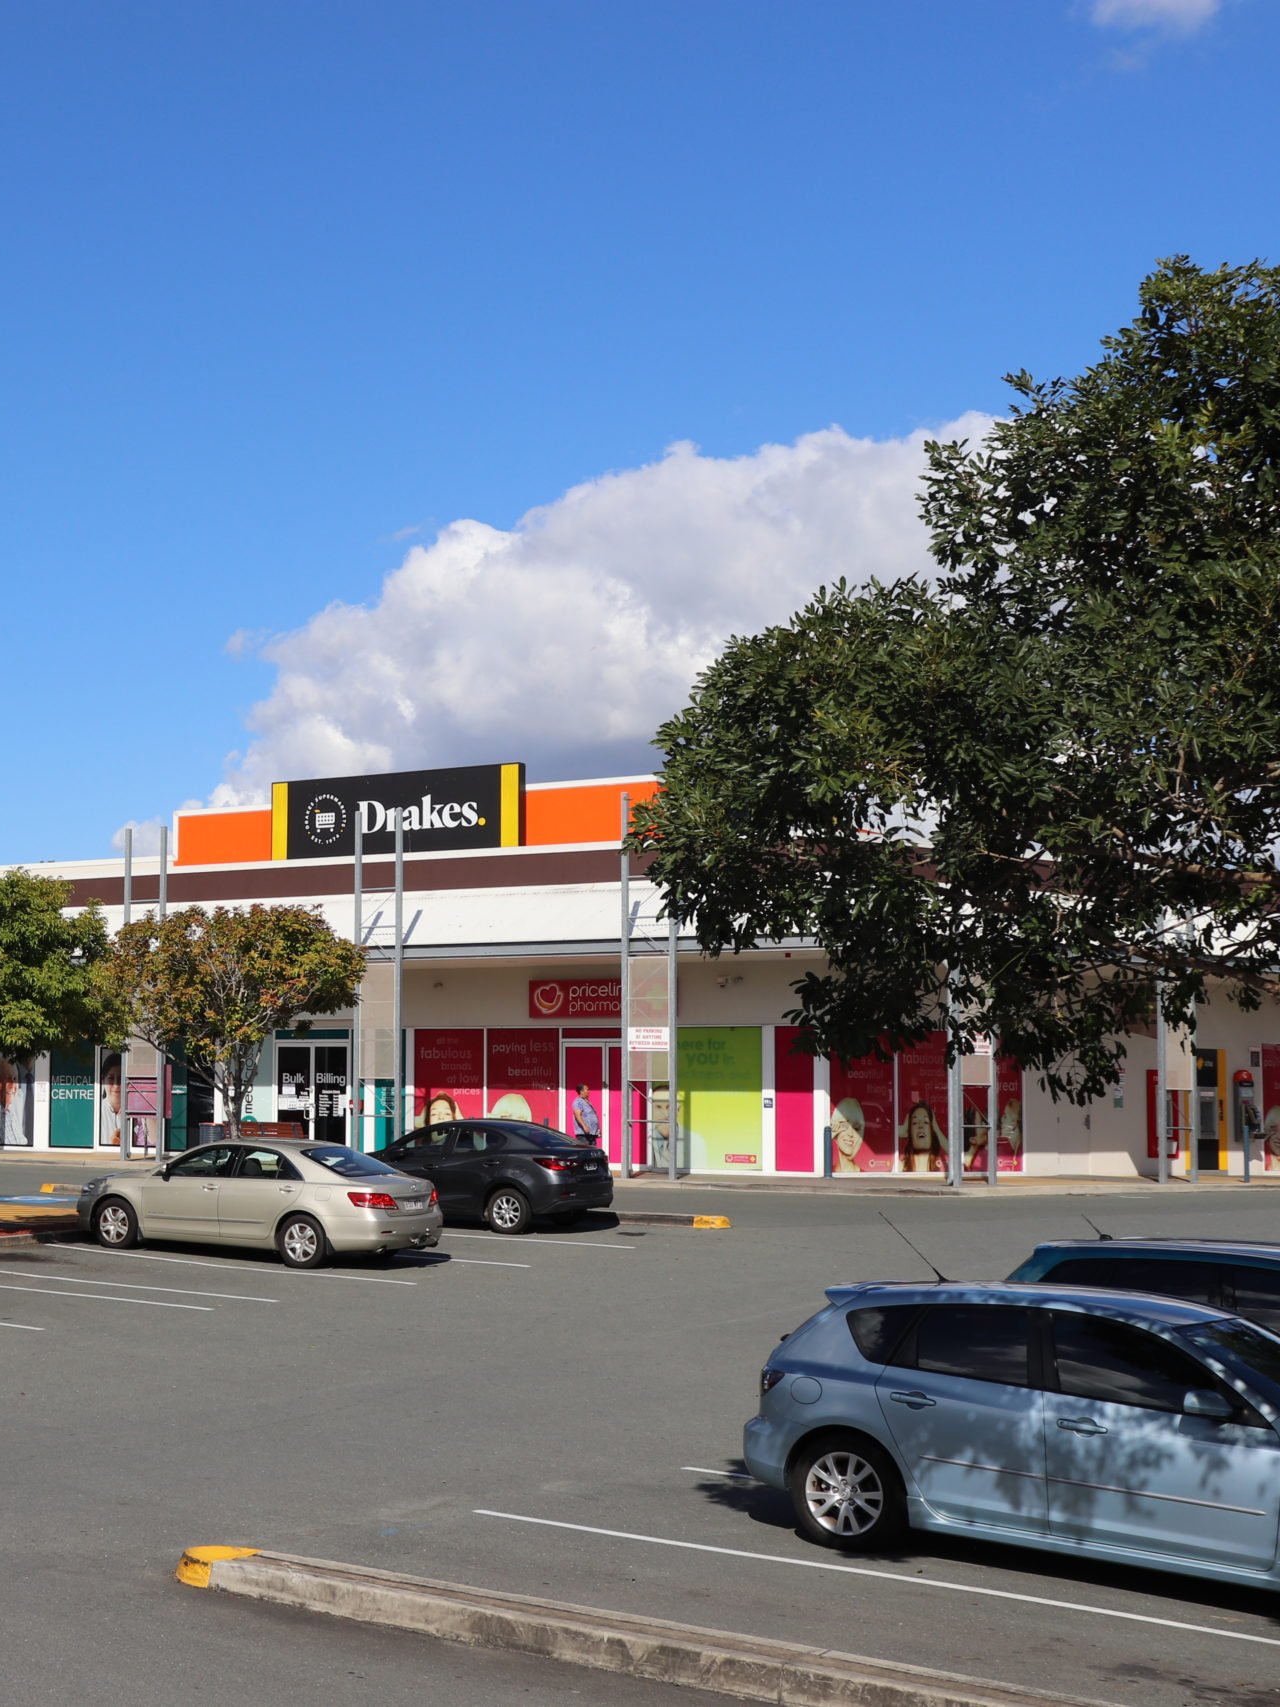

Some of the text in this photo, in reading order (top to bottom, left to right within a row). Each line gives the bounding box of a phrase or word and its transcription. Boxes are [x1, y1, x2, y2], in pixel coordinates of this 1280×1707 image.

[420, 1047, 473, 1059] fabulous
[492, 1039, 555, 1055] paying less
[508, 1066, 552, 1076] beautiful
[51, 1076, 94, 1086] MEDICAL
[282, 1072, 346, 1087] Bulk Billing
[51, 1088, 95, 1100] CENTRE
